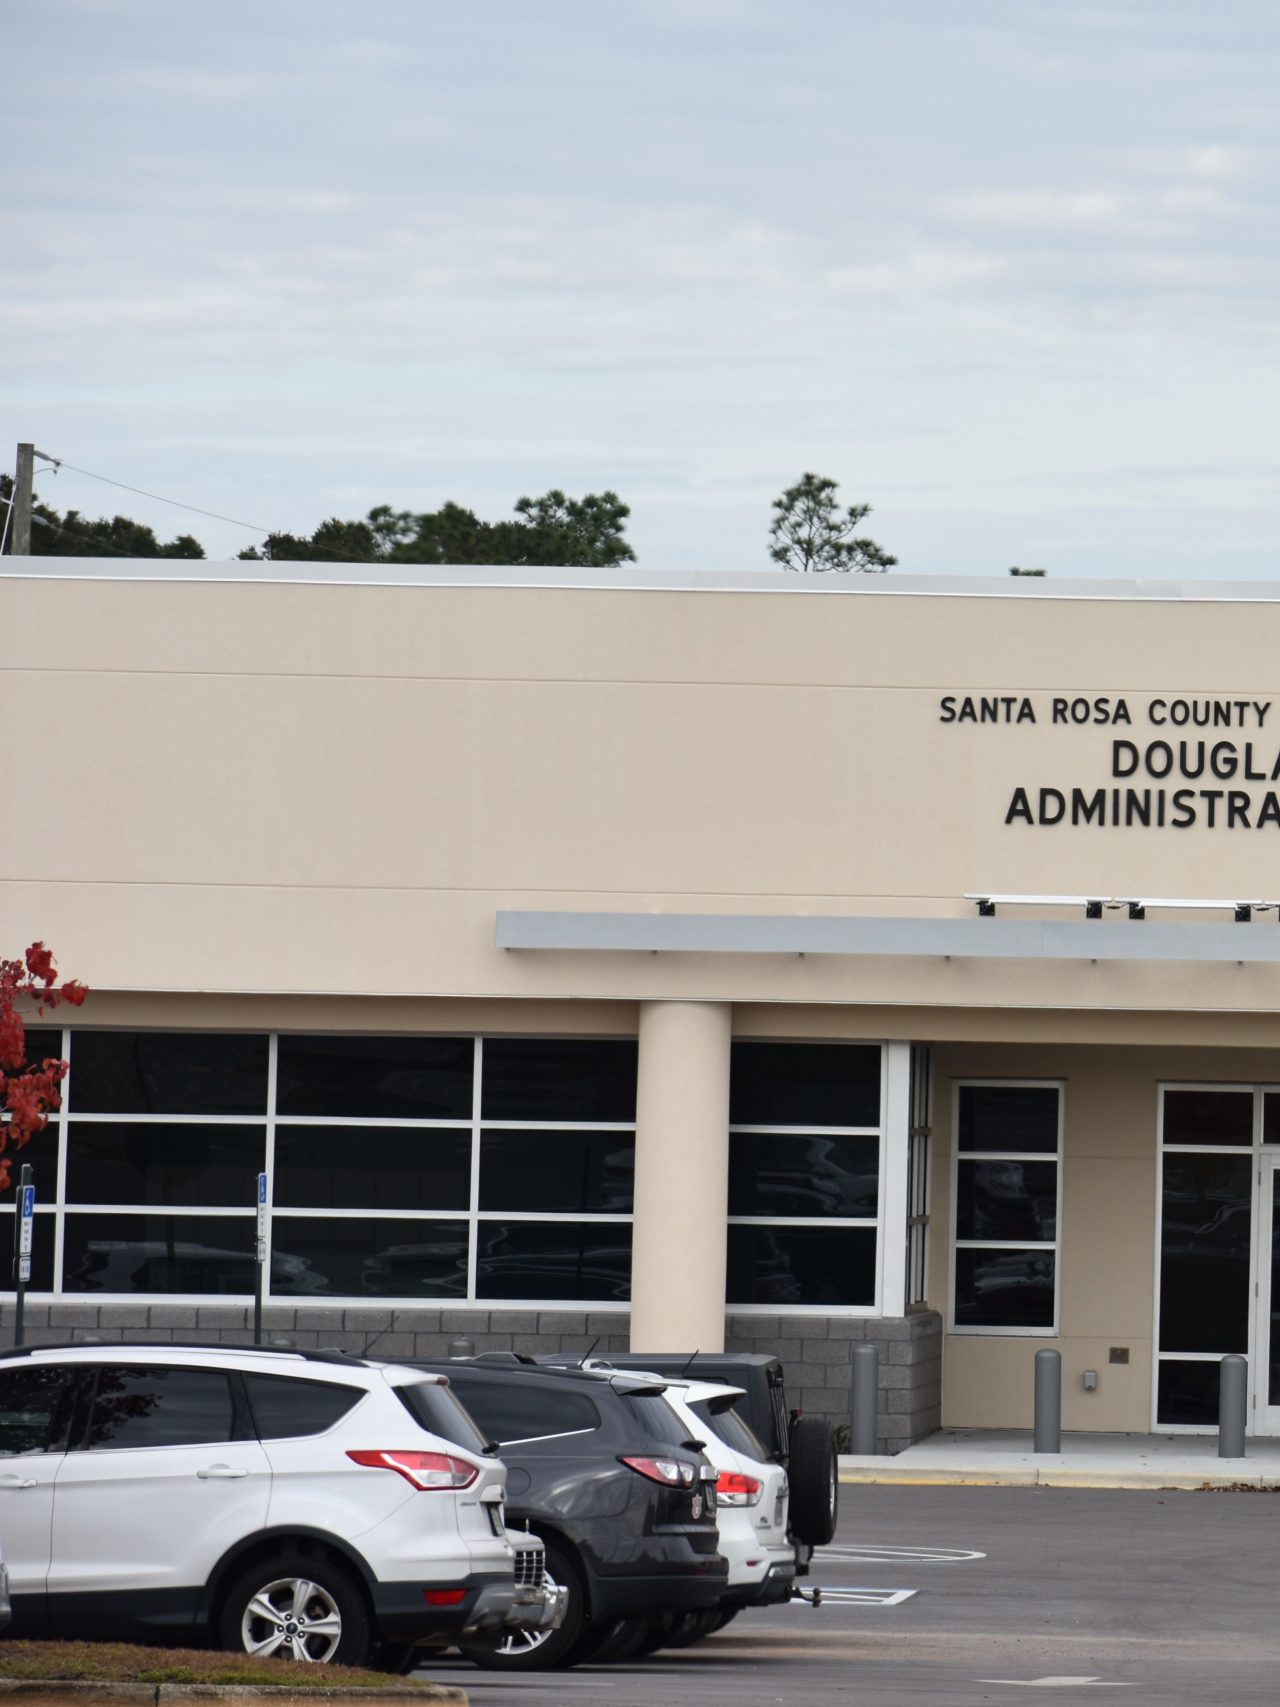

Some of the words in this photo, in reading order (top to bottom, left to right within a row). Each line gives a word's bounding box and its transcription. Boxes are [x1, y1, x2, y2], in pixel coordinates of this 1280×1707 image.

[939, 696, 1037, 724] SANTA
[1052, 697, 1132, 725] ROSA
[1148, 698, 1272, 728] COUNTY
